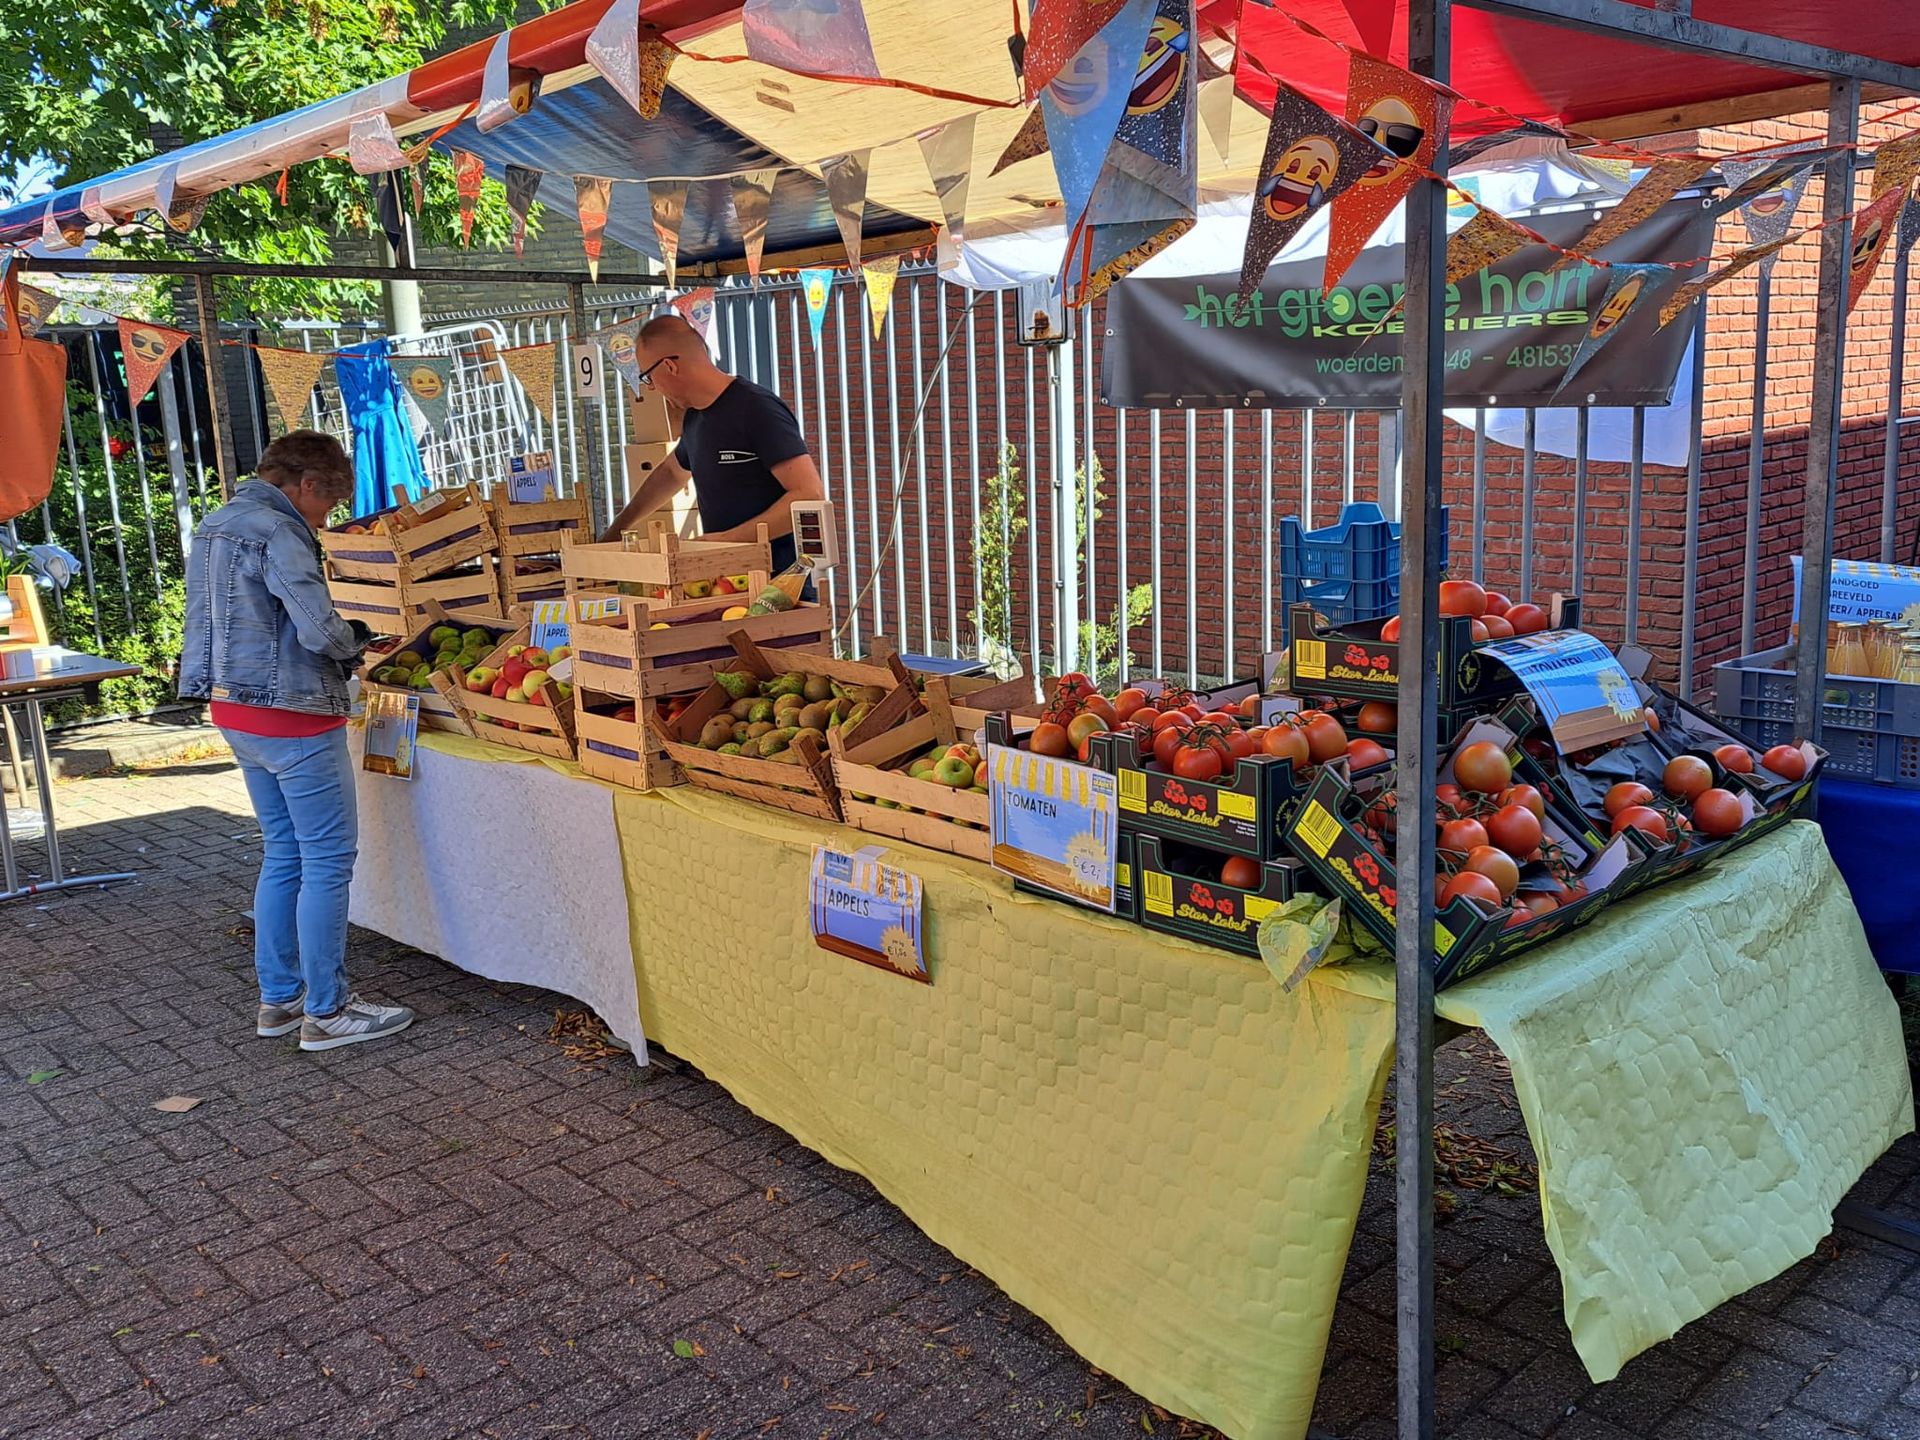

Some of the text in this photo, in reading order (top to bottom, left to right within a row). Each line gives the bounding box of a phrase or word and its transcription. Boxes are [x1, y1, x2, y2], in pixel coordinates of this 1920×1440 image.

[1479, 261, 1594, 314] hart
[1312, 310, 1589, 338] KOEIERS
[581, 356, 593, 386] 9
[1315, 352, 1404, 374] woerden
[1506, 344, 1579, 368] 48153
[516, 476, 537, 489] APPELS
[1830, 590, 1873, 603] REEVELD
[1831, 577, 1880, 590] ANDGOED
[1829, 604, 1904, 621] EER/ APPELSAP
[1328, 665, 1362, 680] Star
[1007, 791, 1057, 818] TOMATEN
[1149, 800, 1182, 818] Star
[1182, 808, 1224, 828] Label
[1328, 857, 1364, 892] Star
[827, 888, 870, 917] APPELS
[1176, 904, 1251, 932] Star Label
